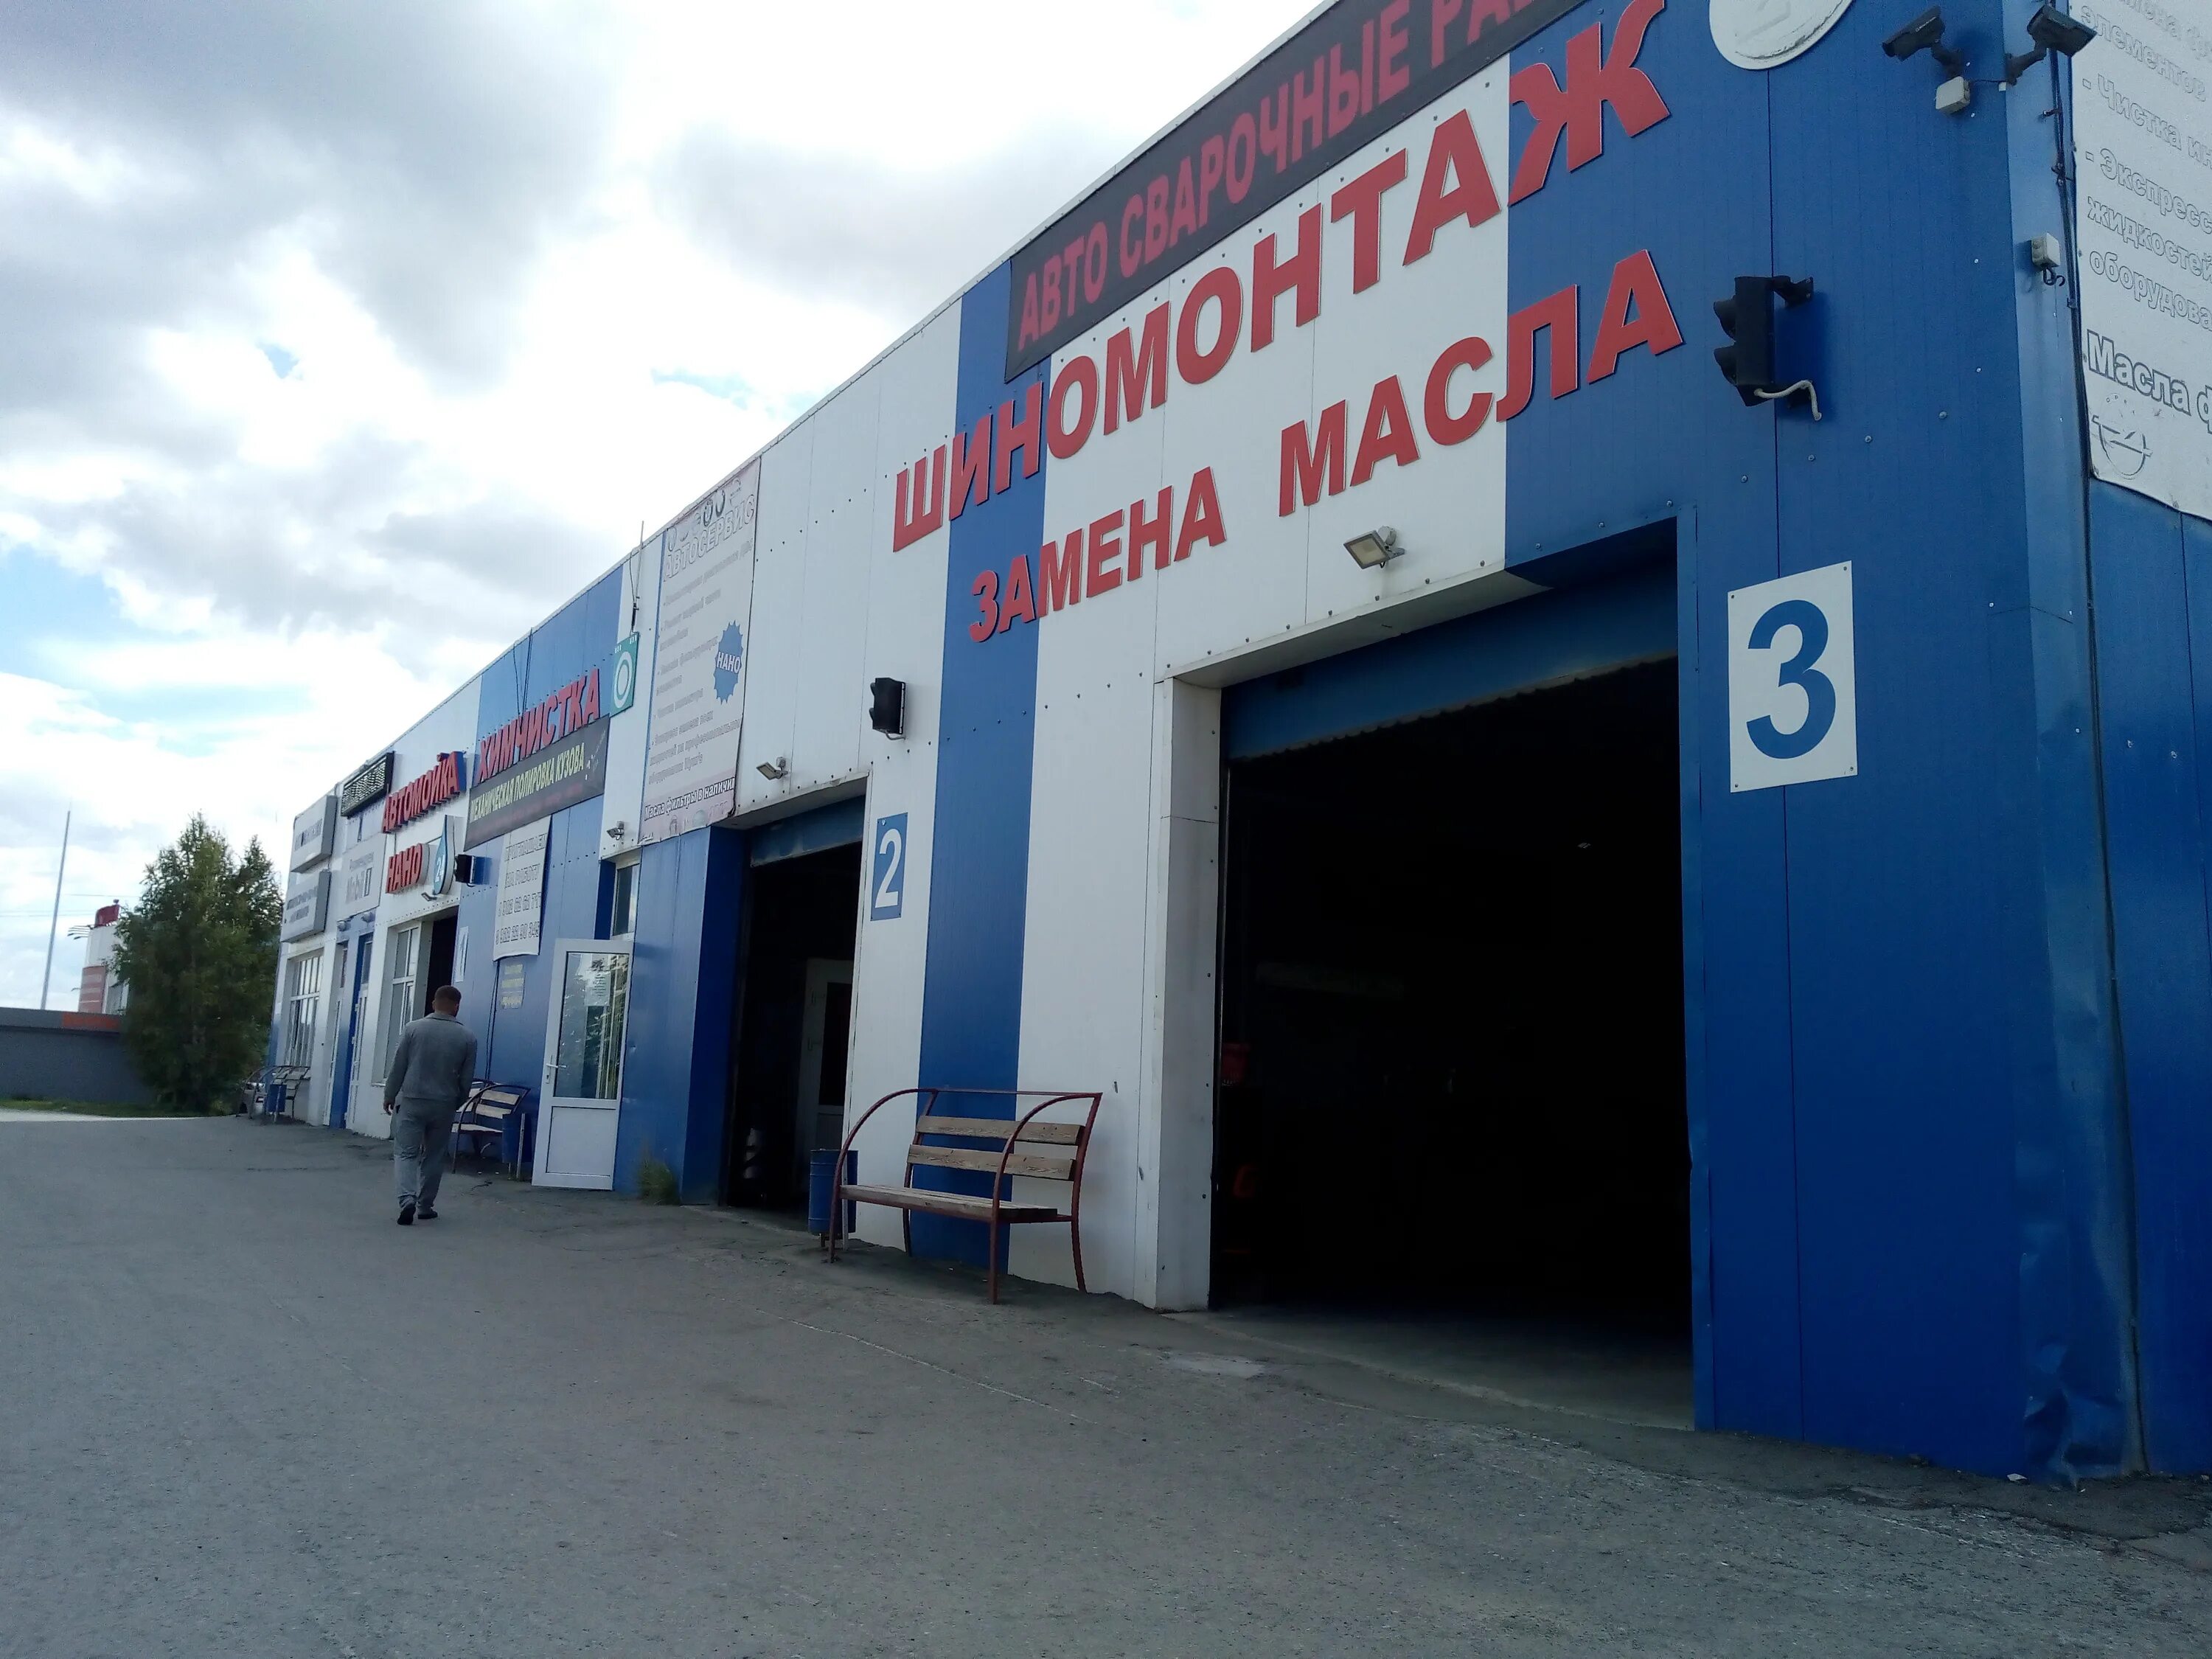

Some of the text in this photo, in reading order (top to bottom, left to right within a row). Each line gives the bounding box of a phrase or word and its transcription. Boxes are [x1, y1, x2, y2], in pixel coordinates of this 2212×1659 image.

[2081, 5, 2206, 102] элементов
[2098, 73, 2182, 151] Чистка
[1018, 221, 1108, 352] АВТО
[1119, 0, 1410, 278] СВАРОЧНЫЕ
[2100, 147, 2212, 234] Экспресс
[893, 0, 1671, 552] ШИНОМОНТАЖ
[2089, 251, 2212, 332] оборудова
[2087, 329, 2192, 417] Масла
[968, 249, 1686, 642] ЗАМЕНА МАСЛА
[663, 494, 755, 582] АВТОСЕРВИС
[716, 651, 741, 674] НАНО
[1746, 599, 1836, 759] 3
[476, 668, 600, 785] ХИМЧИСТКА
[381, 751, 464, 833] АВТОМОЙКА
[514, 757, 554, 801] ПОЛИРОВКА
[555, 742, 584, 782] КУЗОВА
[665, 790, 698, 816] фильтры
[698, 788, 703, 801] в
[386, 843, 423, 894] НАНО
[435, 855, 445, 883] 24
[874, 828, 902, 908] 2
